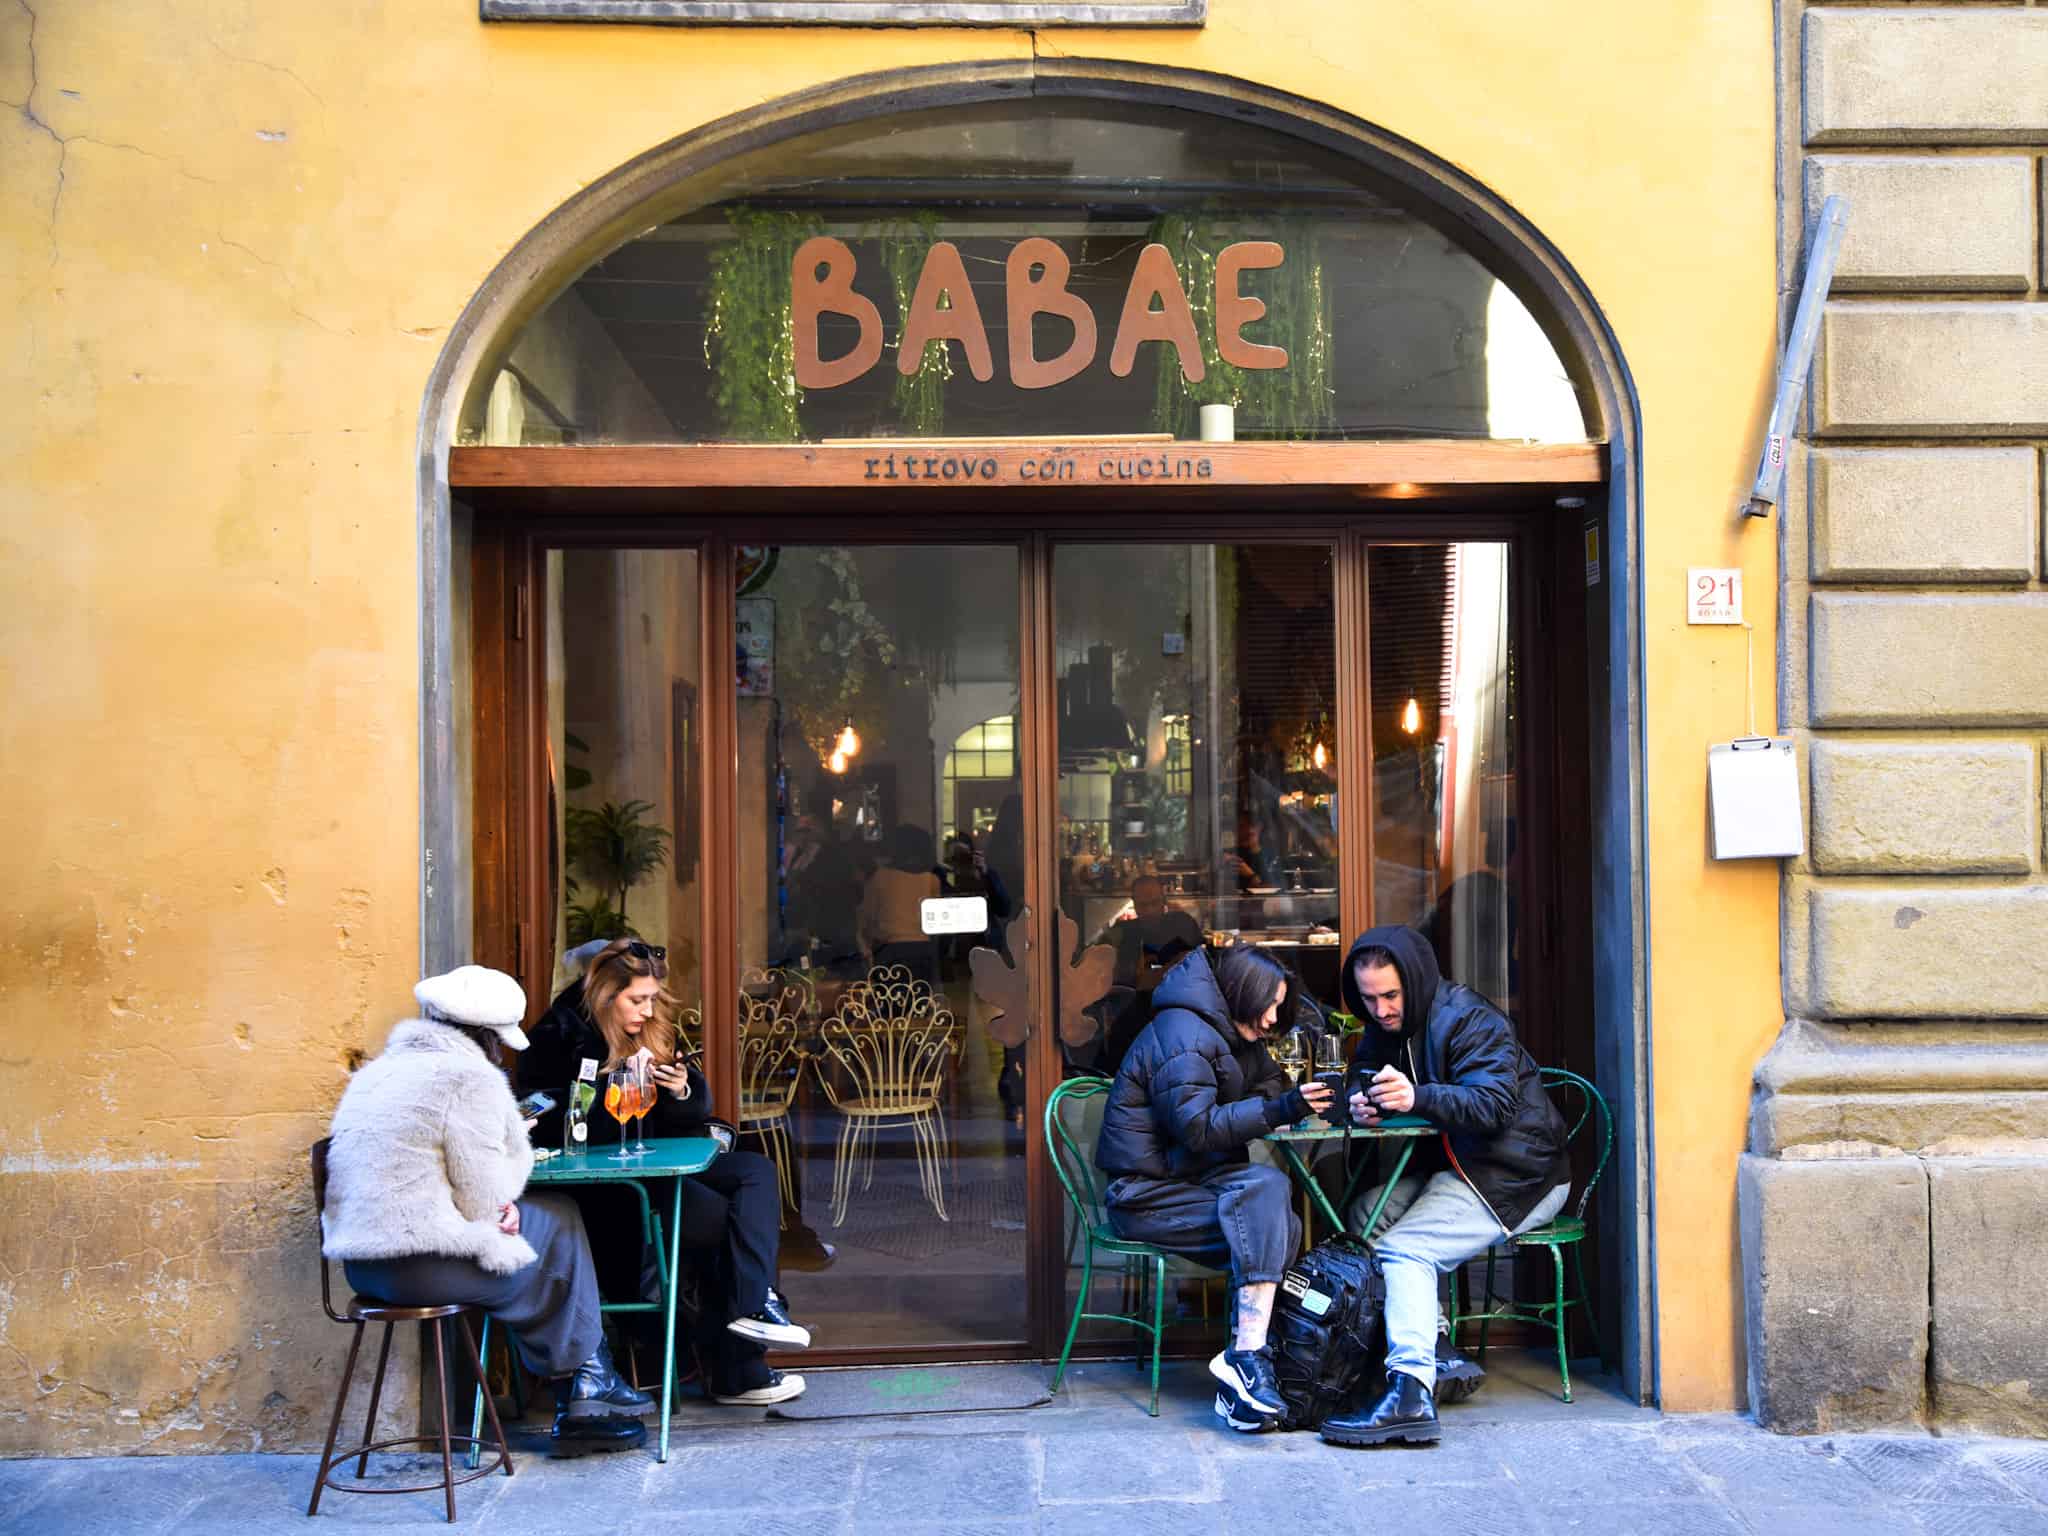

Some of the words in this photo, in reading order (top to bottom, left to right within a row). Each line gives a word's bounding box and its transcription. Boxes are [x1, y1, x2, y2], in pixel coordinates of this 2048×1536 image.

[791, 236, 1289, 389] BABAE
[864, 453, 999, 480] ritrovo
[1020, 455, 1077, 480] con
[1099, 453, 1214, 479] cucina
[1696, 575, 1734, 606] 21
